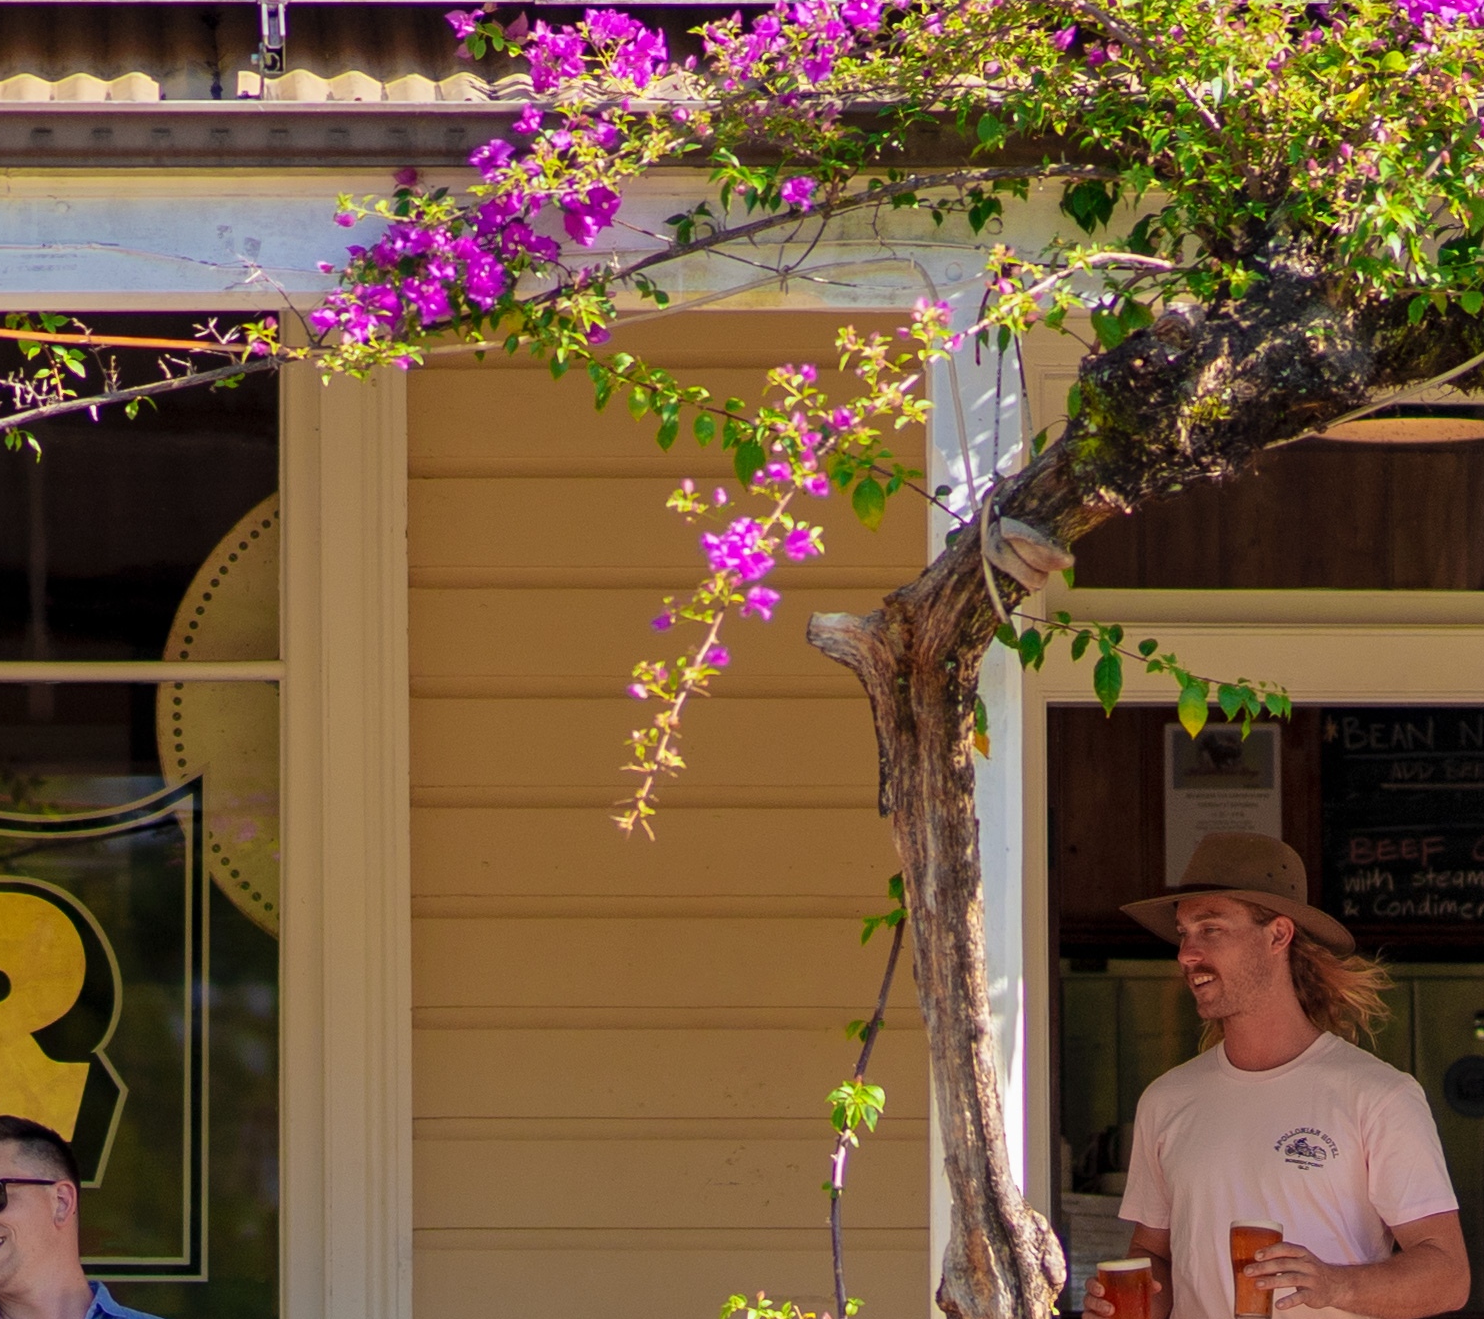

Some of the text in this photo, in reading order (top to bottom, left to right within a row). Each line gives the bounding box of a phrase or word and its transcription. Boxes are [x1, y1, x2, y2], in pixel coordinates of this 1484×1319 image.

[1342, 716, 1435, 751] BEAN
[1347, 836, 1447, 864] BEEF
[1342, 870, 1395, 894] with
[1342, 899, 1360, 918] &
[1321, 1134, 1339, 1159] HOTEL
